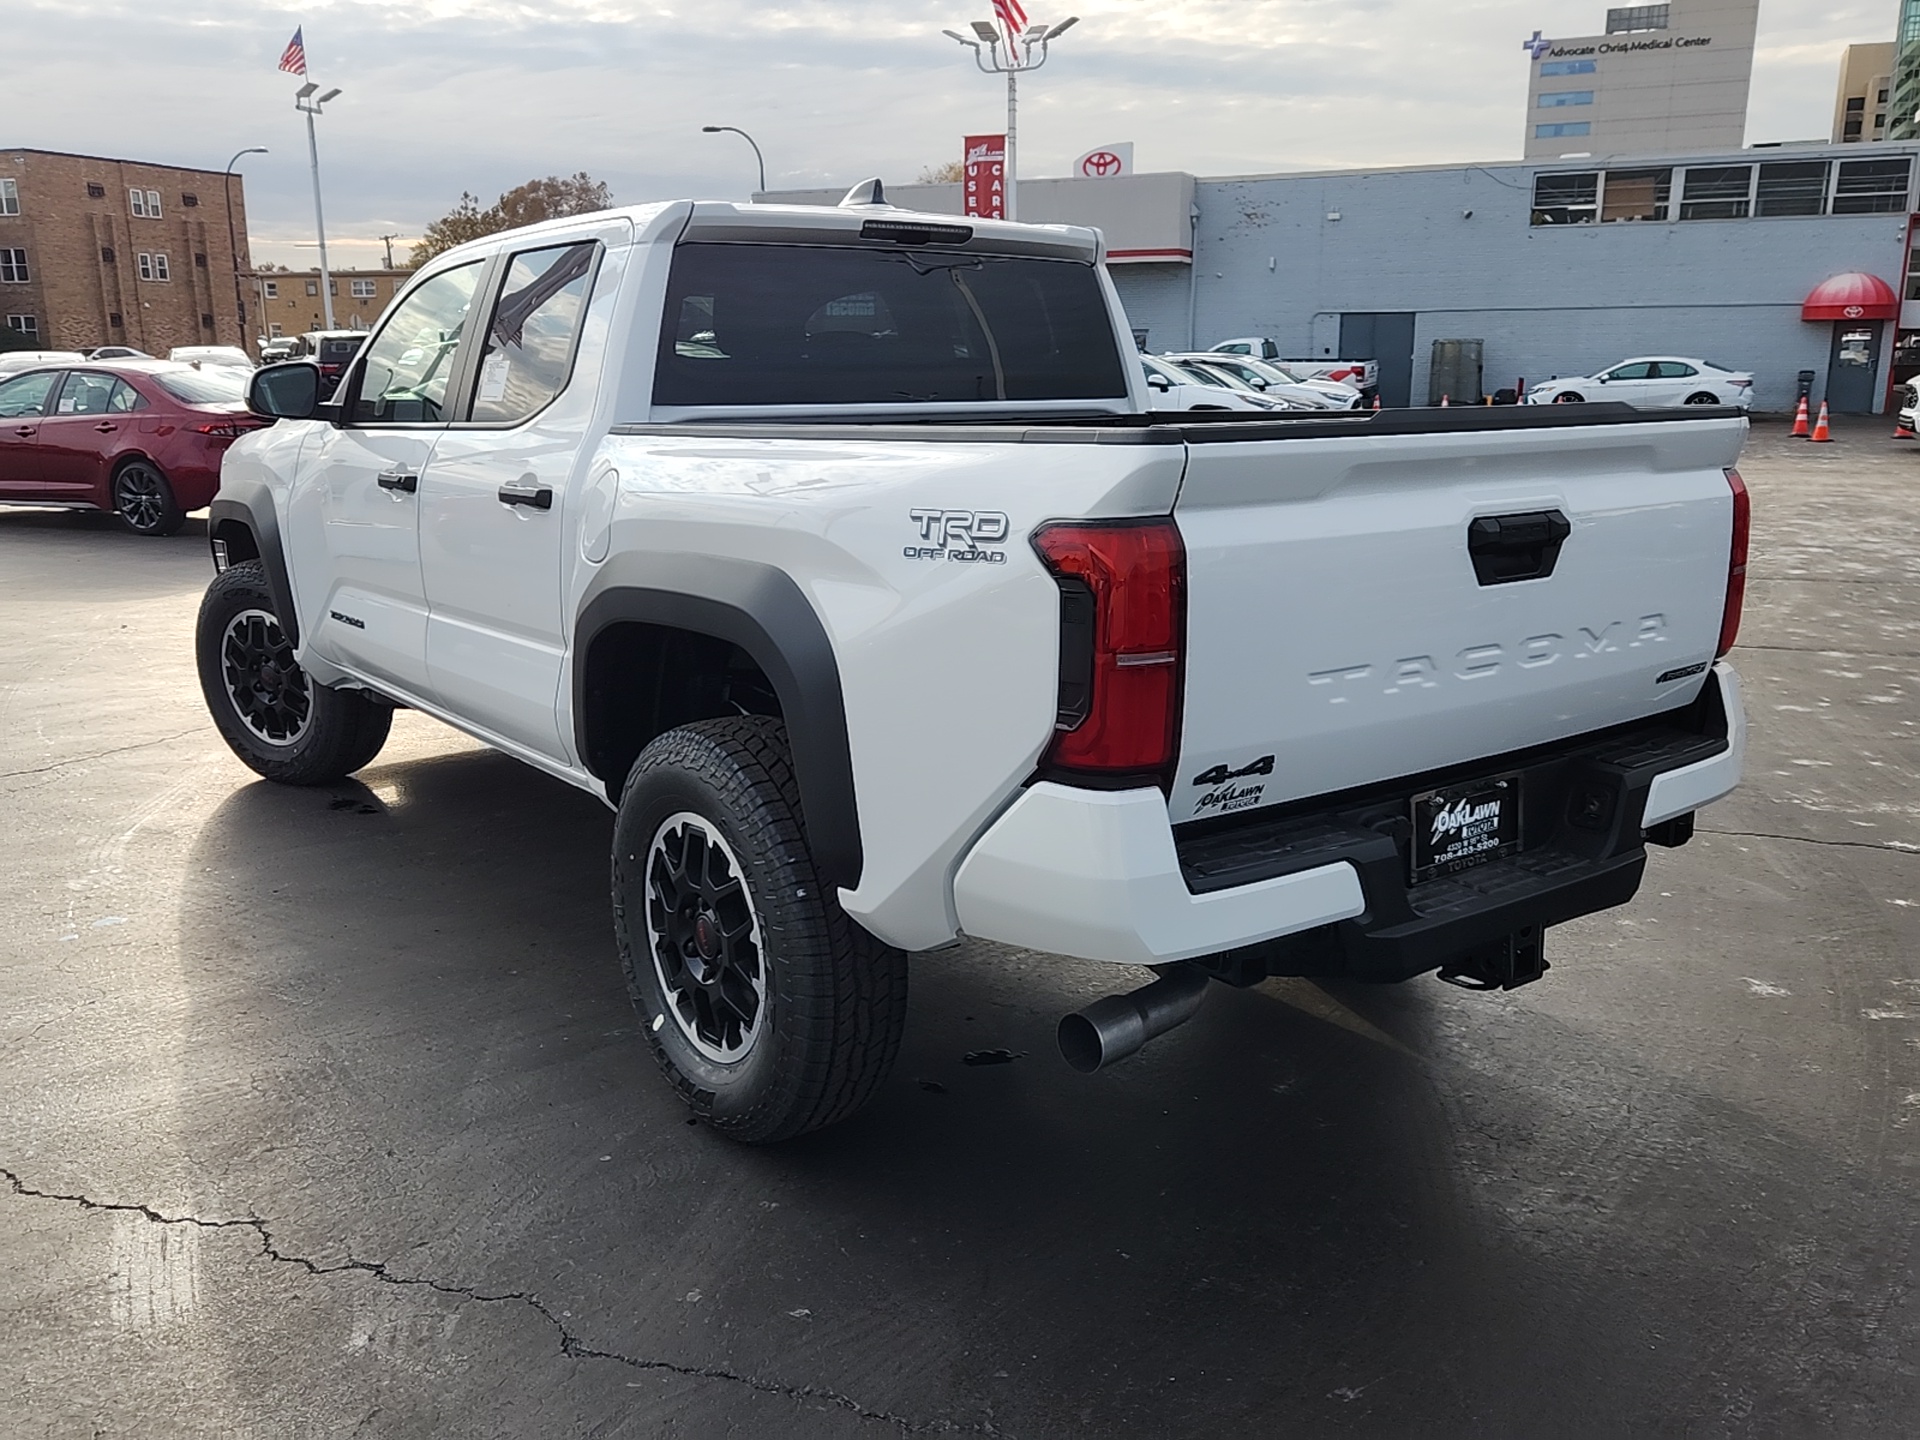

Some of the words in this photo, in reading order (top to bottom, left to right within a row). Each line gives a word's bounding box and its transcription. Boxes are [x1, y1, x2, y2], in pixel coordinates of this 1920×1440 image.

[1549, 46, 1595, 57] Advocate
[1598, 43, 1628, 54] Christ
[1628, 38, 1673, 51] Medical
[1675, 36, 1712, 47] Center
[991, 164, 1002, 219] CARS
[910, 508, 1010, 549] TRD
[903, 546, 945, 560] OFF
[947, 549, 1008, 565] ROAD
[1306, 612, 1670, 705] TACOMA
[1433, 838, 1500, 864] 708-423-5200
[1448, 853, 1488, 872] TOYOTA
